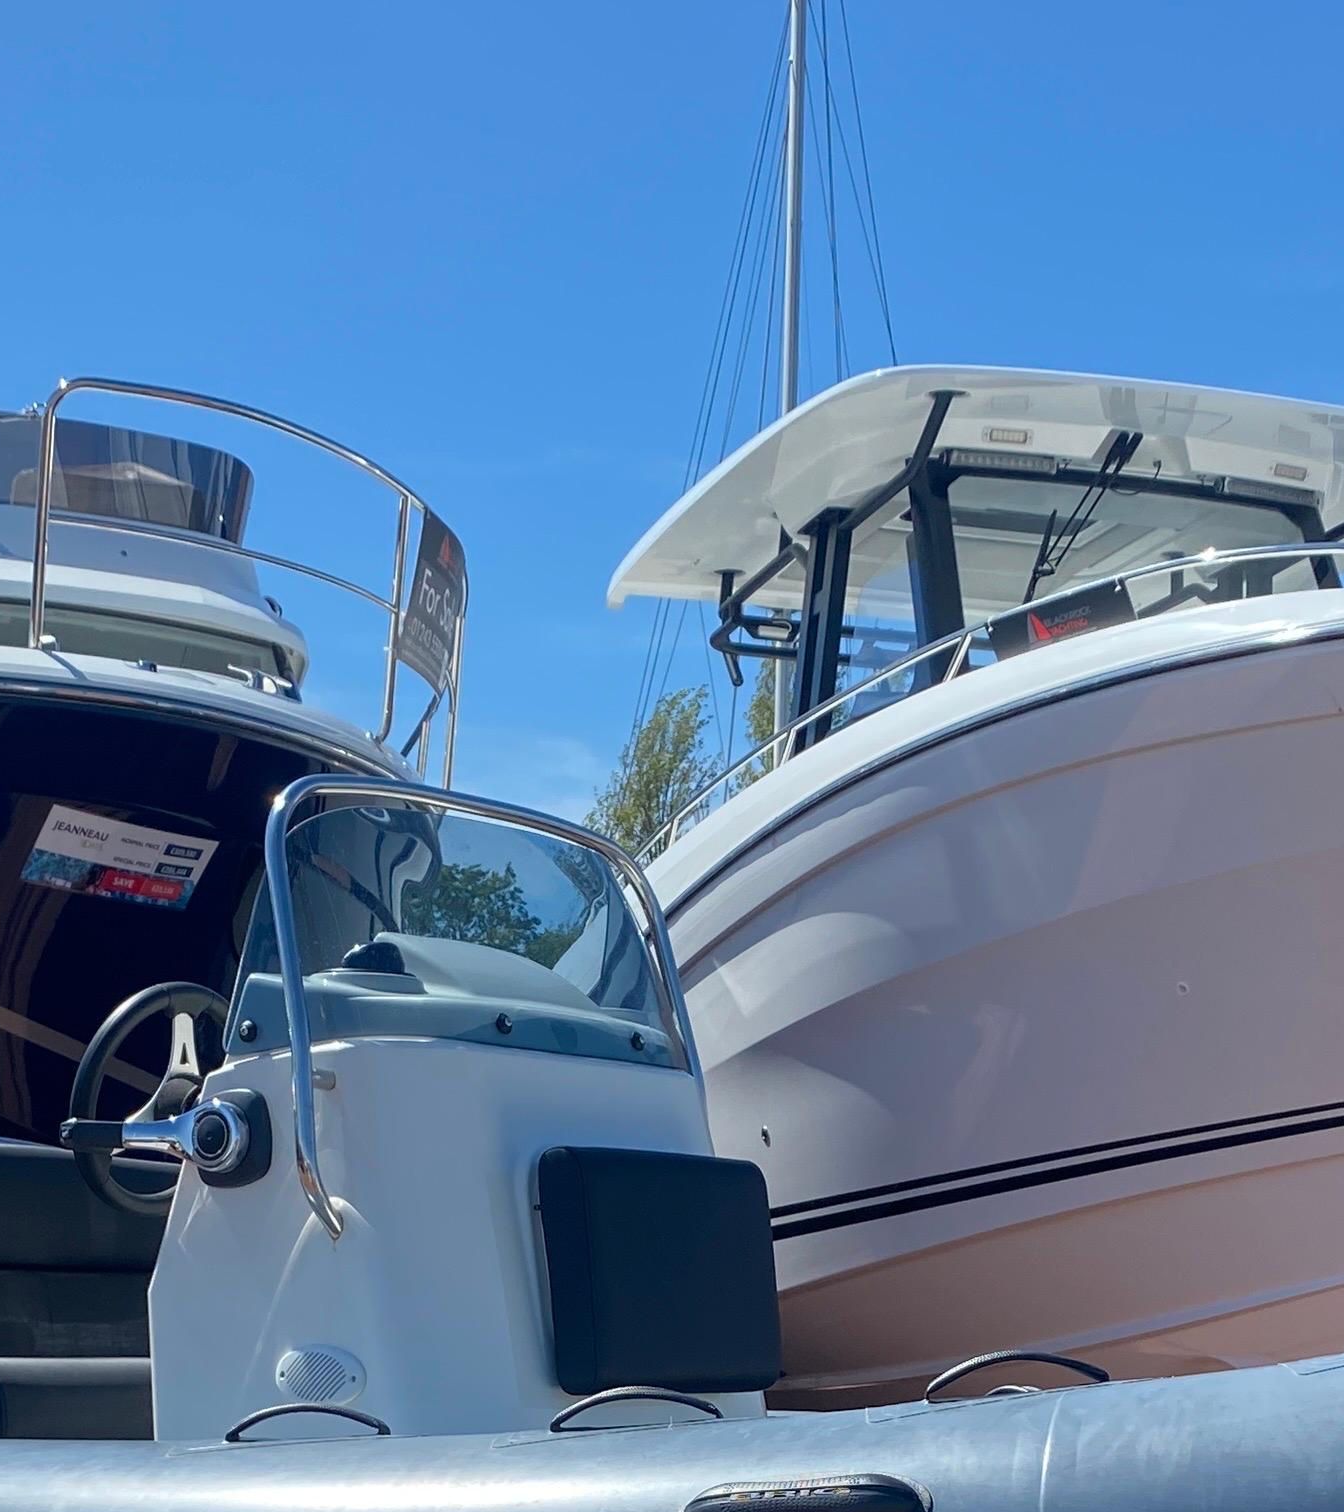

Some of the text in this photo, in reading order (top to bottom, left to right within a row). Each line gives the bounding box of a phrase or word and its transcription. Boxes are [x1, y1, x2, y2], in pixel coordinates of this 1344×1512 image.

[419, 568, 441, 617] For
[52, 820, 109, 842] JEANNEAU
[112, 875, 135, 889] SAVE
